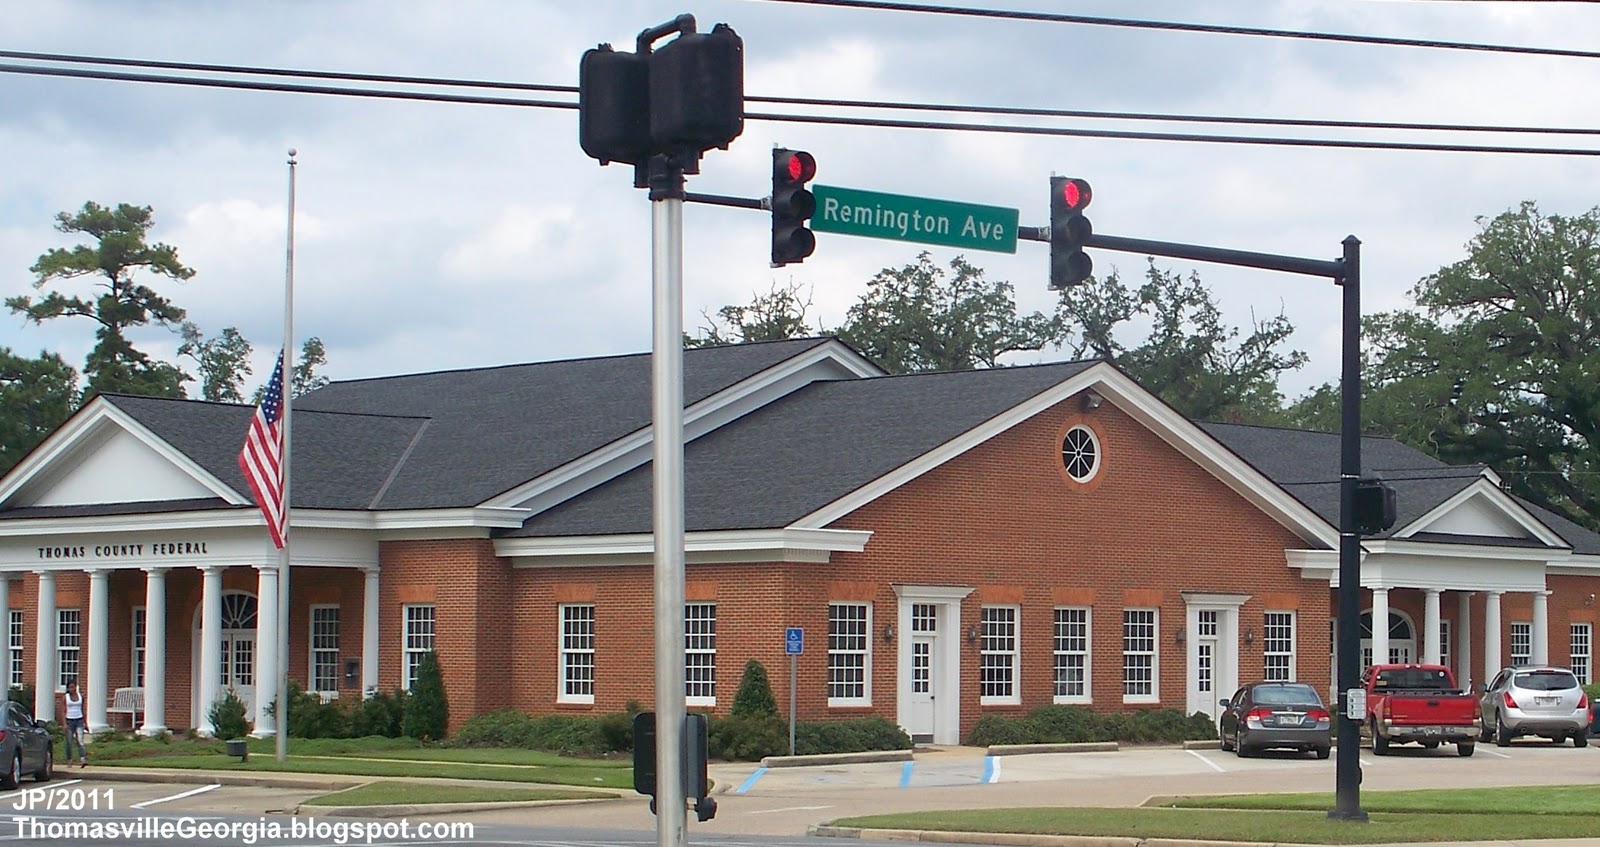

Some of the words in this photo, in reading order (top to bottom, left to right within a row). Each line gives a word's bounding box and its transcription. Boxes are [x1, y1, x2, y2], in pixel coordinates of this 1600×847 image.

[824, 197, 949, 237] Remington
[961, 215, 1004, 240] Ave
[38, 546, 85, 559] THOMAS
[95, 544, 144, 557] COUNTY
[153, 542, 208, 555] FEDERAL
